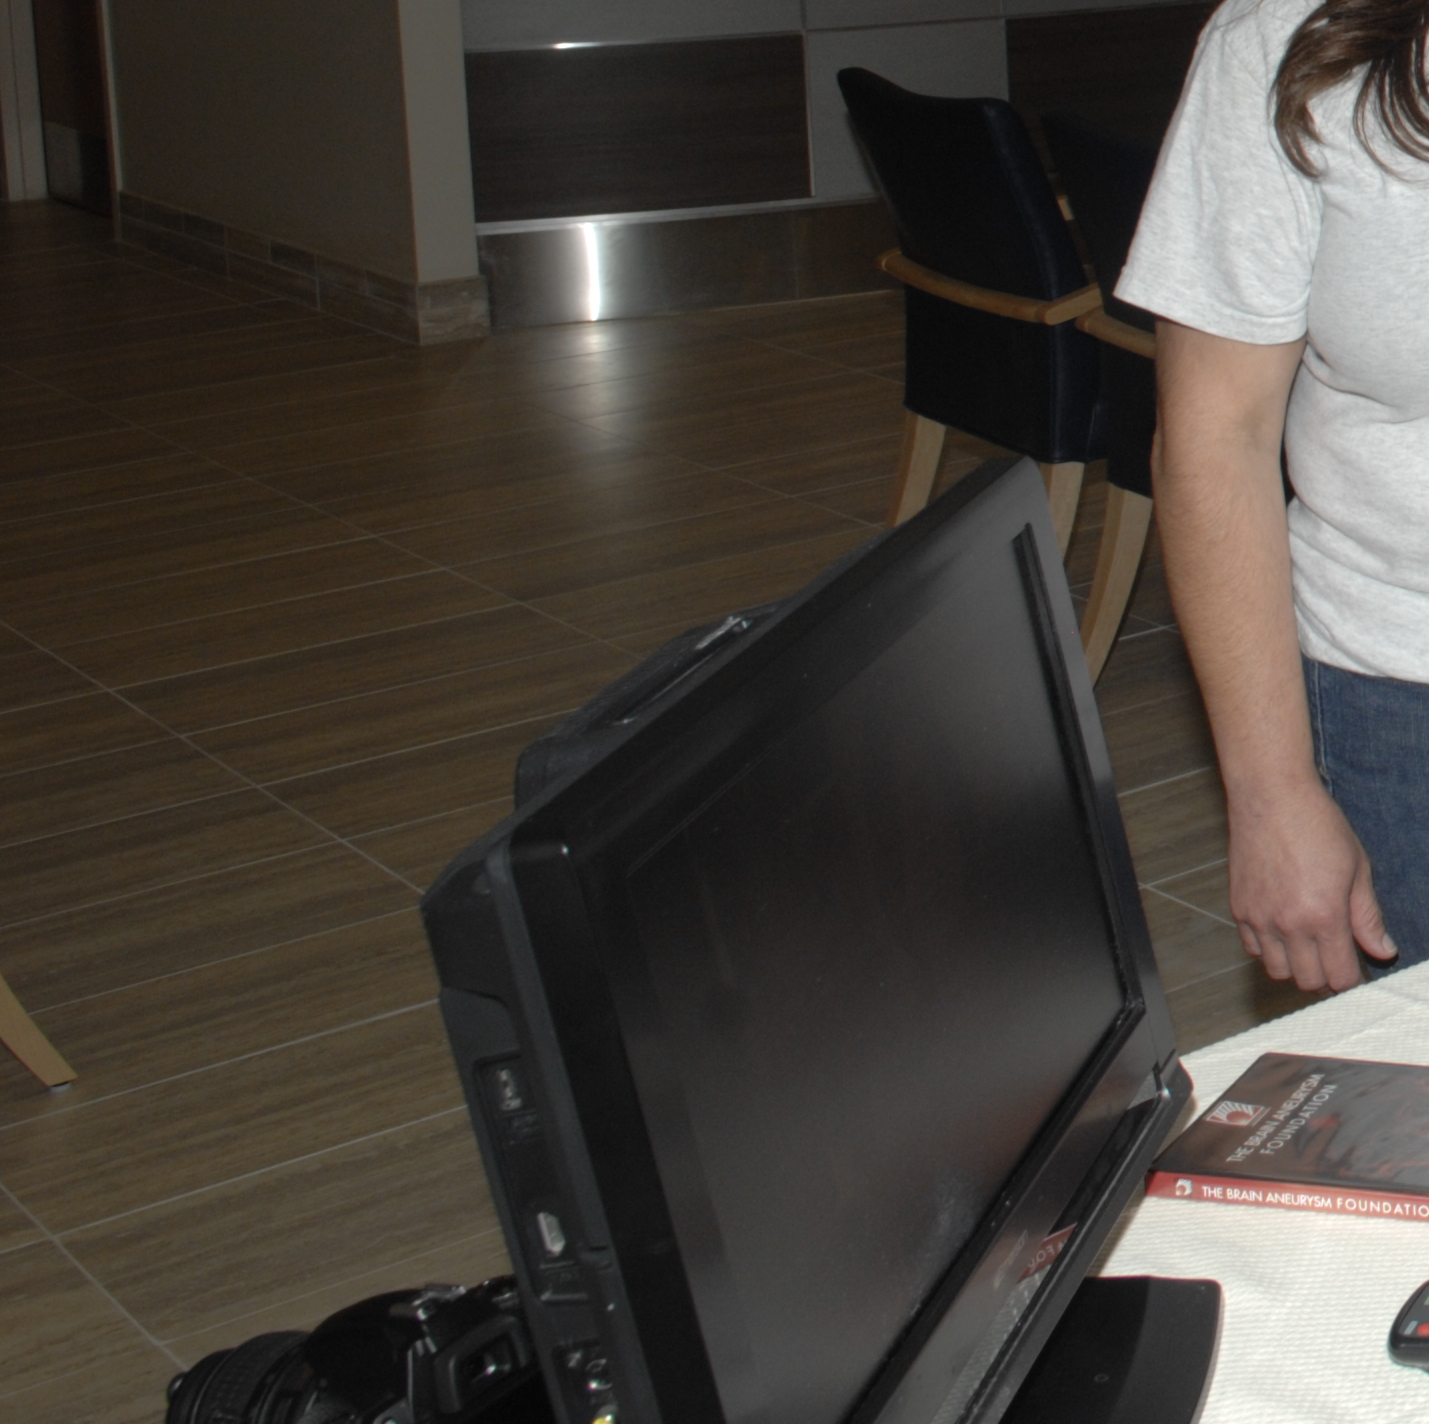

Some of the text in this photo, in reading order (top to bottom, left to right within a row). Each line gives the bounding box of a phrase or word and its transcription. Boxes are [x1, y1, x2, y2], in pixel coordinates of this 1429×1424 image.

[1225, 1073, 1326, 1162] THE BRAIN ANEURYSM
[1259, 1084, 1338, 1155] FOUNDATION
[1201, 1186, 1224, 1199] THE
[1225, 1187, 1263, 1203] BRAIN
[1265, 1191, 1333, 1209] ANEURYSM
